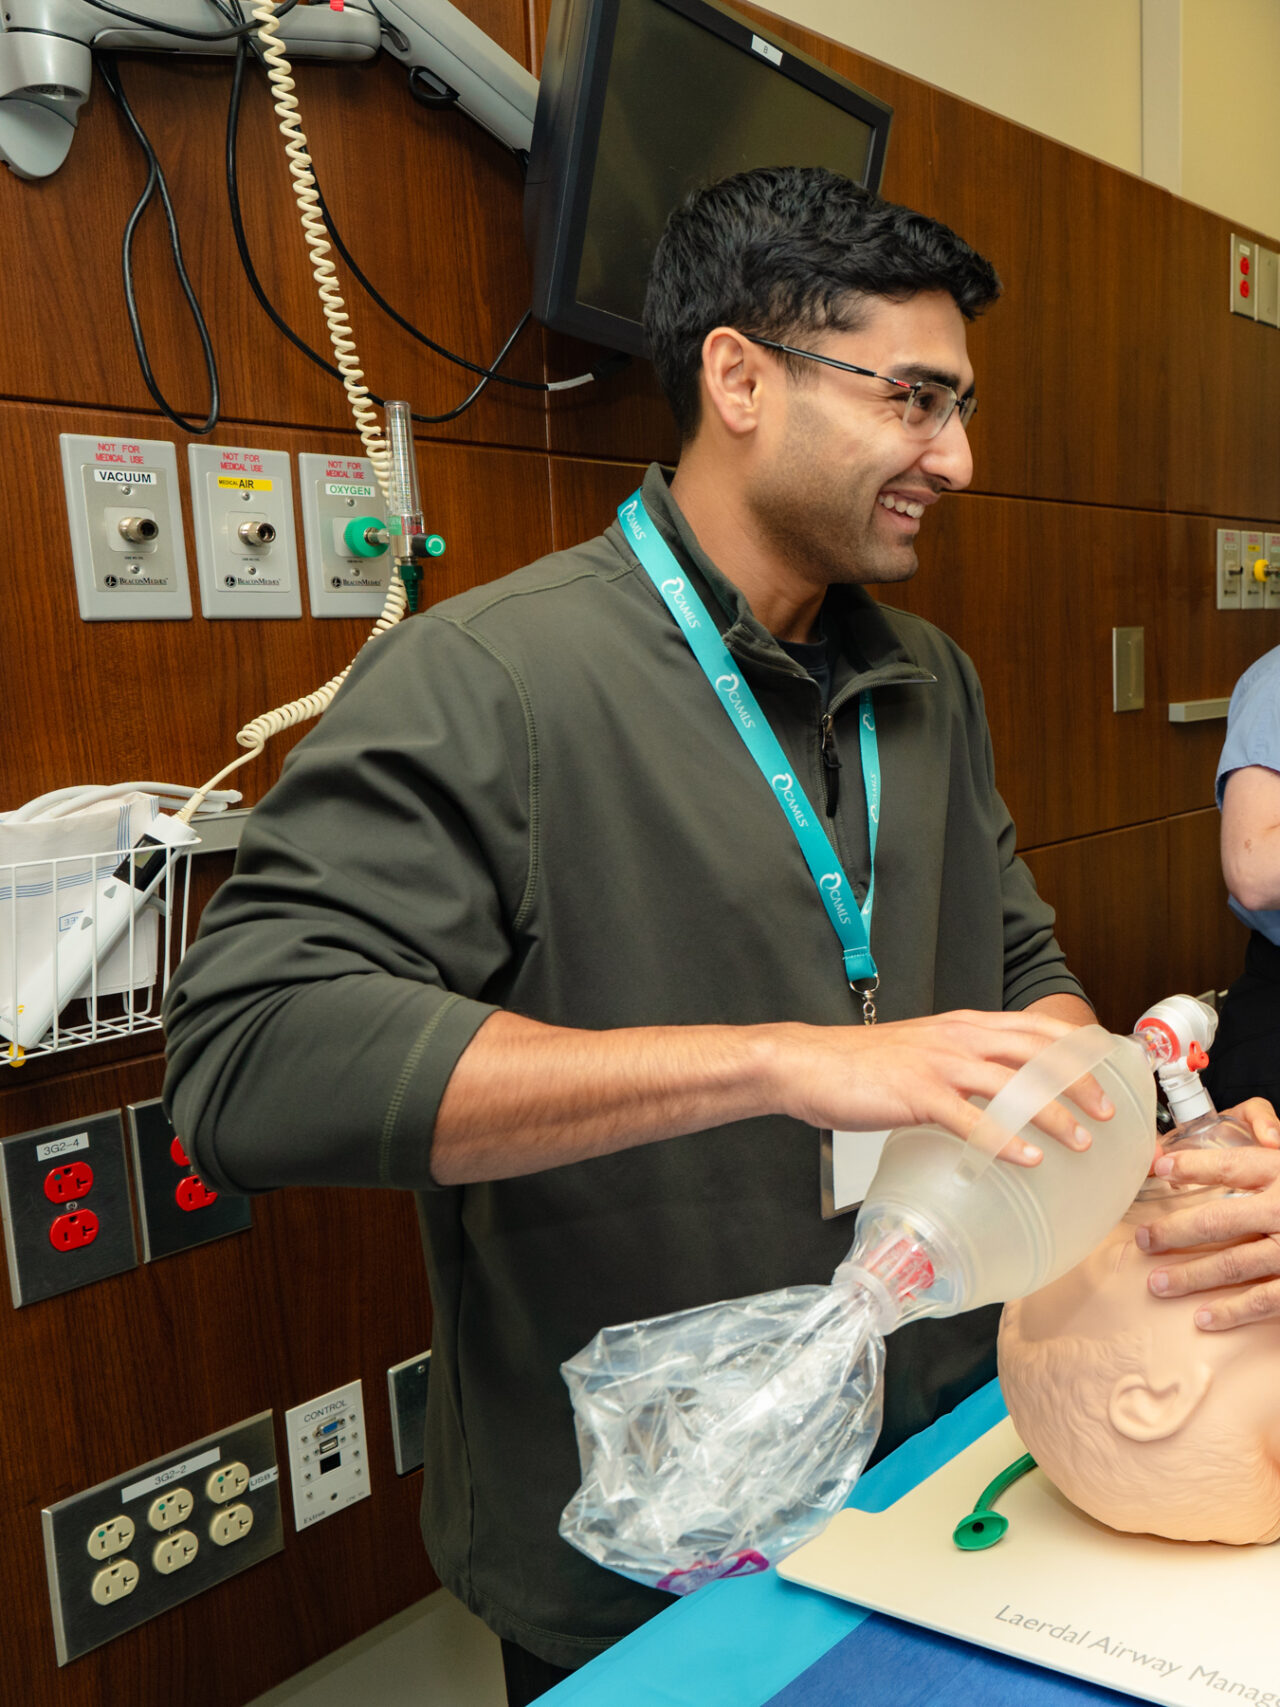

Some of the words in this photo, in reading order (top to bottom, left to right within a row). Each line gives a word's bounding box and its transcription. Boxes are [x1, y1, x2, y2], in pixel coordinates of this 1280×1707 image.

[97, 443, 115, 452] NOT
[121, 444, 141, 454] FOR
[95, 453, 127, 463] MEDICAL
[129, 454, 145, 465] USE
[222, 451, 239, 461] NOT
[243, 453, 260, 463] FOR
[220, 462, 249, 472] MEDICAL
[250, 464, 264, 473] USE
[327, 460, 343, 469] NOT
[346, 461, 362, 470] FOR
[99, 471, 152, 484] VACUUM
[325, 470, 350, 479] MEDICAL
[352, 471, 365, 480] USE
[238, 480, 255, 489] AIR
[329, 484, 372, 496] OXYGEN
[43, 1138, 79, 1156] 3G2-4
[303, 1400, 347, 1423] CONTROL
[154, 1464, 187, 1485] 3G2-2
[250, 1474, 271, 1487] USB
[994, 1604, 1092, 1646] Laerdal
[1087, 1635, 1183, 1678] Airway
